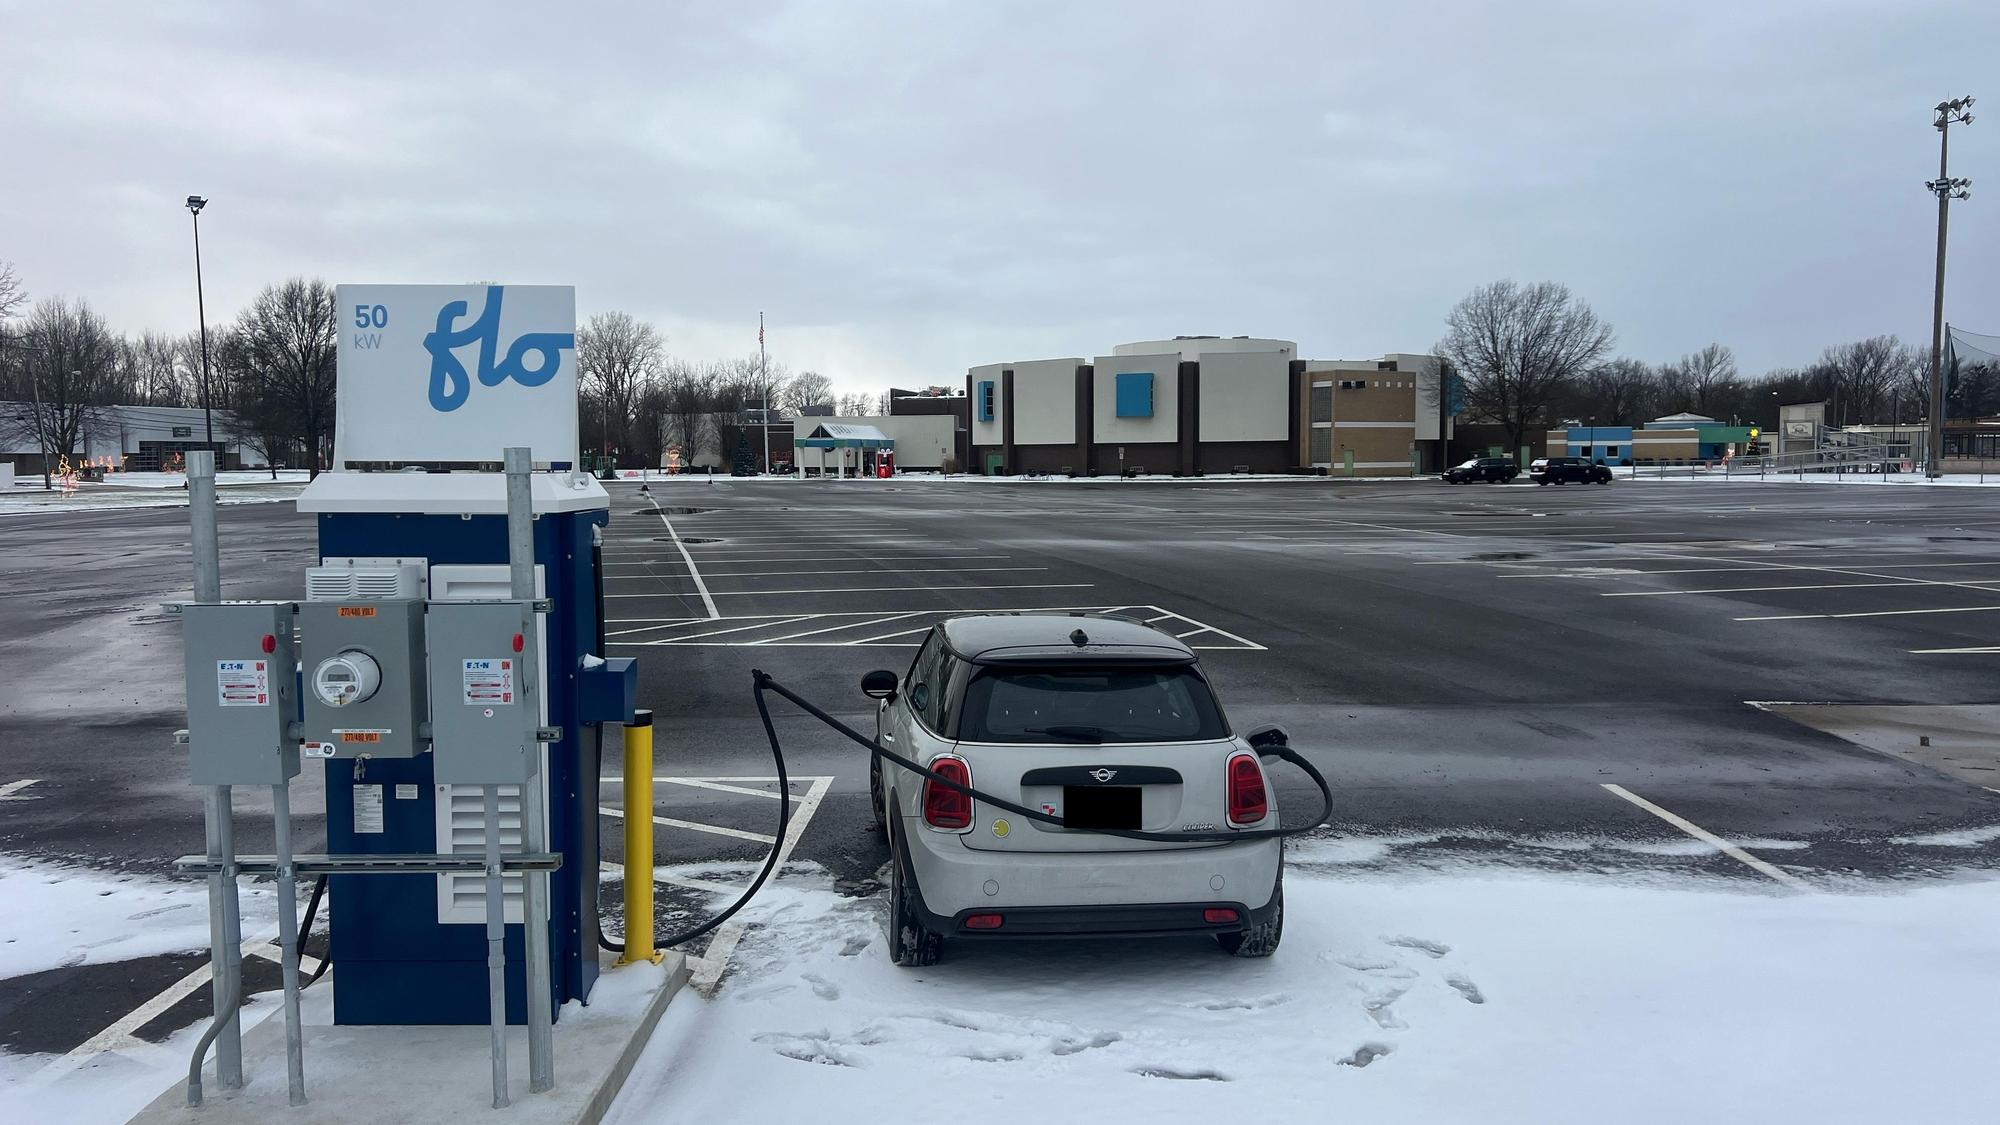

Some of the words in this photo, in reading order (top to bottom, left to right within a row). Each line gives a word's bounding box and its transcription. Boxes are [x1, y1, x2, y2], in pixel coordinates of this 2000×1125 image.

[354, 304, 388, 329] 50
[354, 333, 382, 350] kW
[422, 285, 575, 412] flo
[256, 662, 265, 671] ON
[501, 661, 511, 670] ON
[257, 693, 267, 704] OFF
[502, 692, 512, 703] OFF
[365, 733, 377, 741] VOLT
[1183, 823, 1216, 832] COOPER
